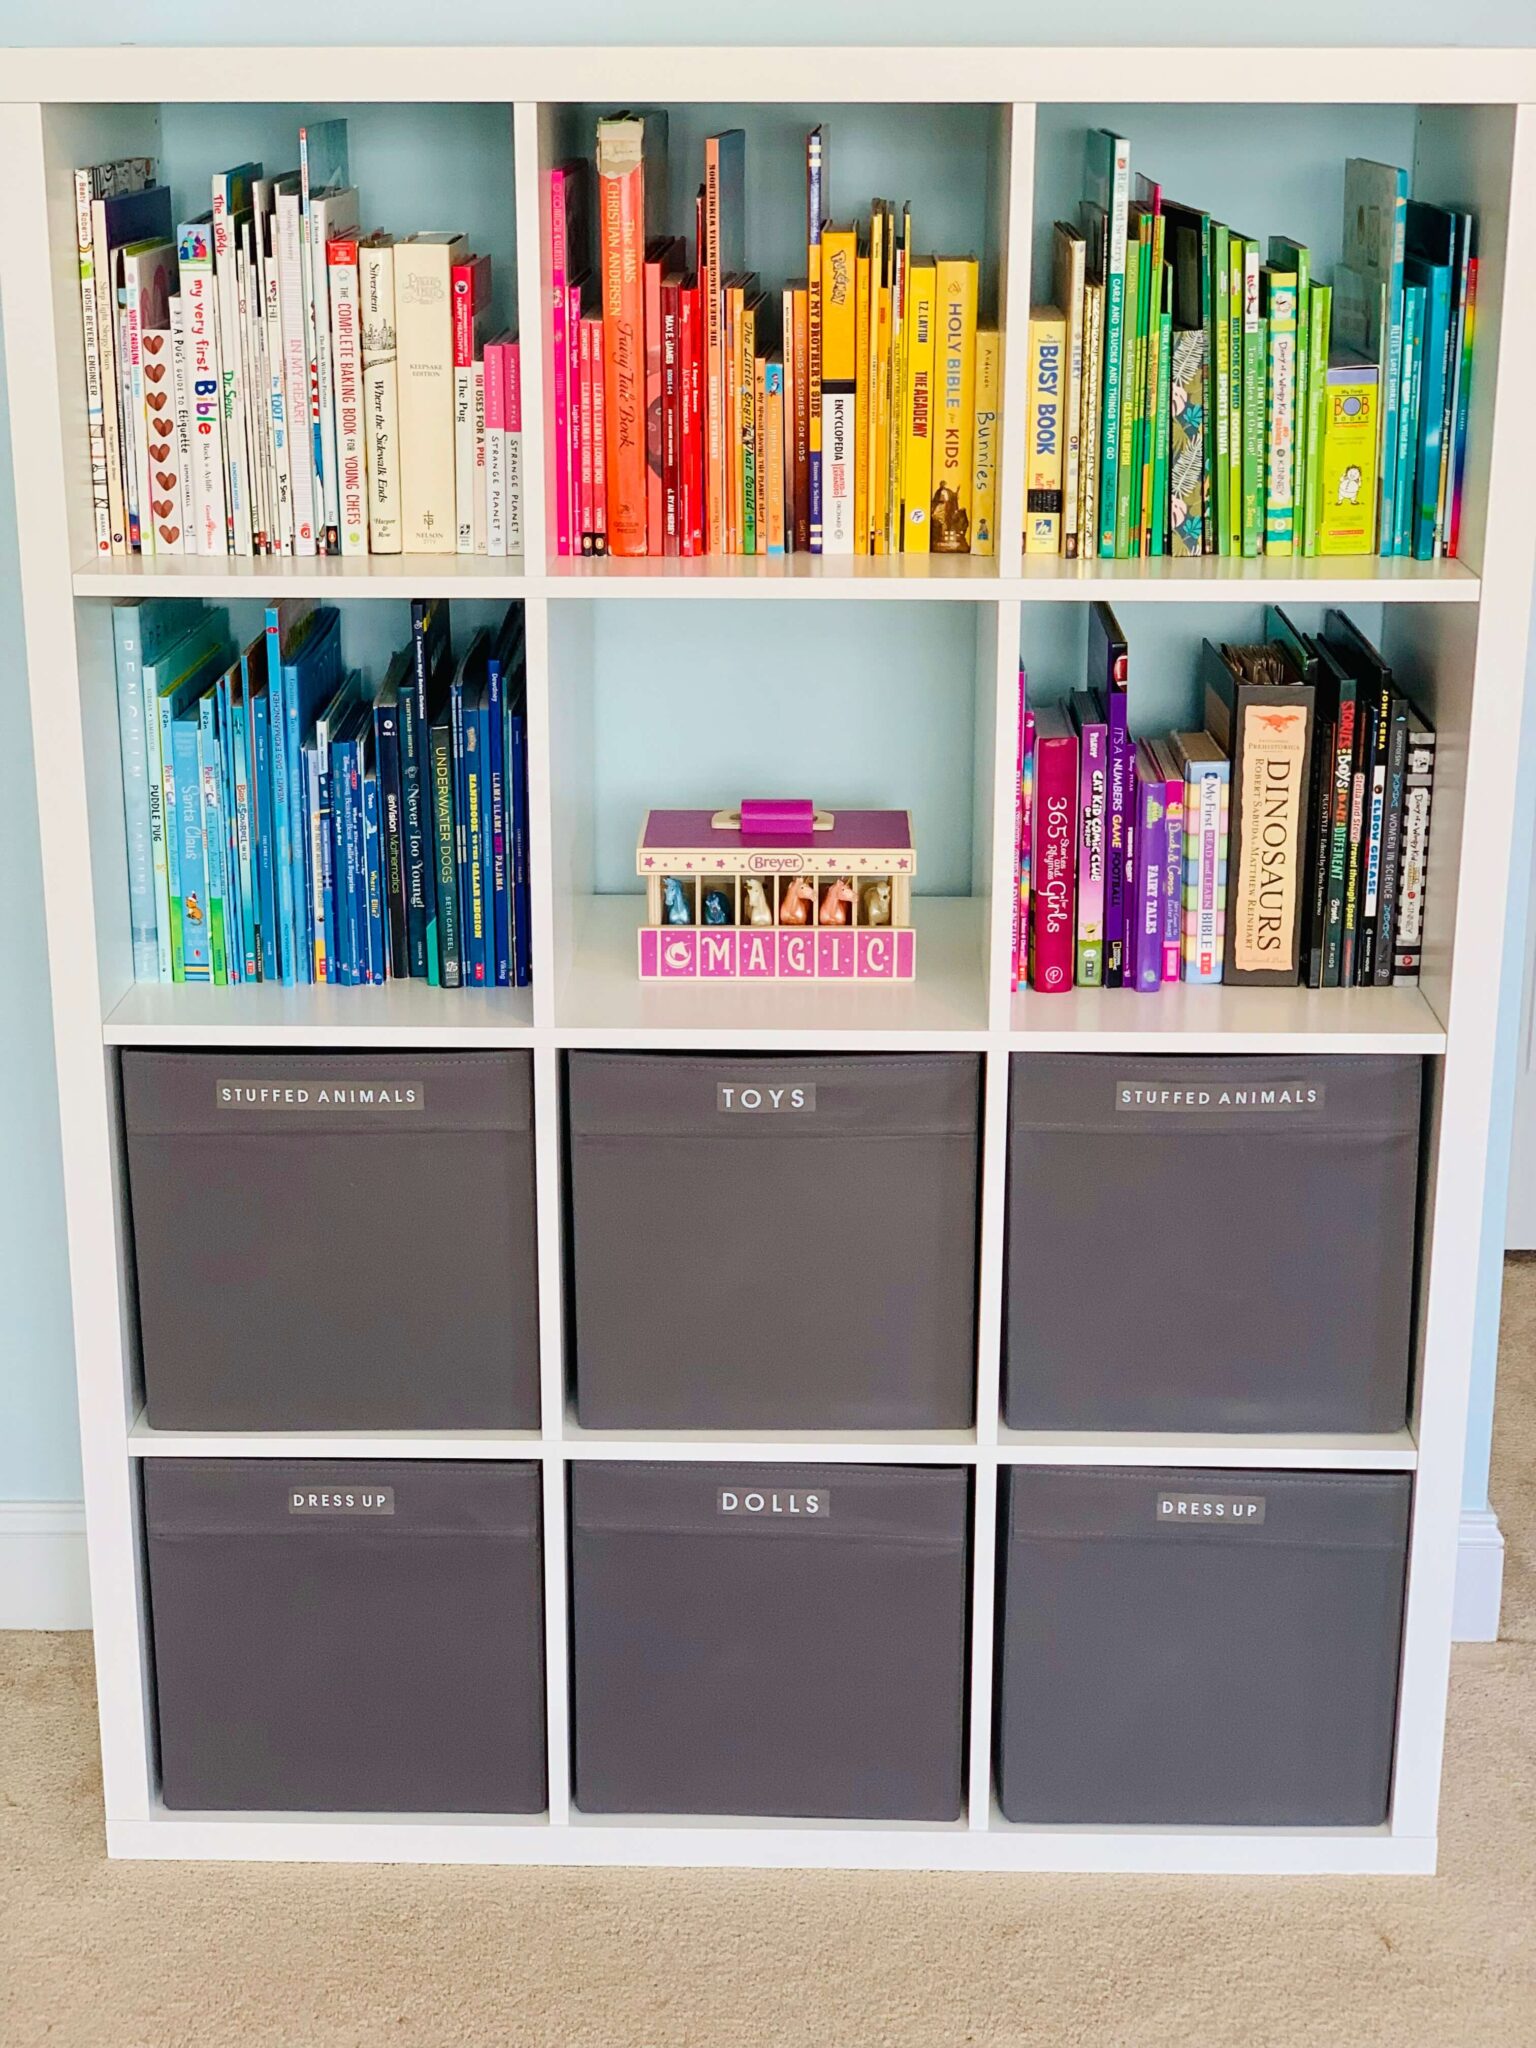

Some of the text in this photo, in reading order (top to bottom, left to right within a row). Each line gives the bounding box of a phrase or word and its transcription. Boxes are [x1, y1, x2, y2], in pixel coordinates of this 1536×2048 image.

[213, 194, 225, 214] The
[606, 181, 622, 317] CHRISTIAN ANDERSEN
[622, 219, 637, 284] The HANS
[708, 163, 718, 347] THE GREAT BAGGERMANIA WIMMELBOOK
[368, 261, 380, 313] Silverstein
[84, 288, 98, 396] ROSIE ENGINEER
[128, 309, 140, 365] NORTH CAROLINA
[189, 280, 218, 435] my very first Bible
[665, 315, 674, 331] MAX
[810, 281, 821, 418] BY MY BROTHER'S SIDE
[1232, 336, 1241, 367] BOOK
[1279, 341, 1288, 364] Diary
[409, 363, 443, 371] KEEPSAKE
[458, 376, 468, 423] The Pug
[612, 320, 636, 453] Fairy Tale Book
[945, 303, 962, 469] HOLY BIBLE KIDS
[1037, 345, 1059, 396] BUSY
[1106, 278, 1121, 460] CARS AND TRUCKS AND THINGS THAT GO
[177, 409, 190, 454] Etiquette
[293, 382, 306, 426] HEART
[338, 287, 361, 526] THE COMPLETE BAKING BOOK FOR YOUNG CHEFS
[475, 373, 485, 467] 101 USES FOR A PUG
[744, 321, 755, 510] The Little Could
[833, 399, 844, 461] ENCYCLOPEDIA
[912, 371, 928, 438] THE ACADEMY
[1036, 403, 1057, 455] BOOK
[1122, 401, 1133, 426] CLASS
[1218, 371, 1229, 455] SPORTS TRIVIA
[1333, 396, 1370, 417] BOB
[374, 380, 388, 504] Where the Sidewalk Ends
[798, 441, 806, 462] KIDS
[976, 411, 996, 491] Bunnies
[491, 436, 501, 530] STRANGE PLANET
[510, 439, 520, 534] STRANGE PLANET
[491, 673, 499, 702] Dewdney
[1378, 688, 1389, 750] JOHN CENA
[1339, 700, 1356, 749] STORIES
[150, 784, 162, 842] PUDDLE PUG
[181, 785, 201, 860] Santa Claus
[435, 746, 451, 842] UNDERWATER
[1090, 770, 1104, 882] CAT CLUB
[1110, 726, 1124, 907] IT'S A NUMBERS GAME FOOTBALL
[1251, 757, 1265, 839] ROBERT SABUDA
[1410, 794, 1424, 862] Diary Wimpy Kid
[387, 794, 400, 894] enVision Mathematics
[407, 783, 425, 908] Never Too Young!
[440, 845, 453, 884] DOGS
[468, 773, 482, 939] HANDBOOK GALAR REGION
[492, 772, 503, 892] LLAMA LLAMA PAJAMA
[753, 856, 800, 872] Breyer
[1037, 795, 1070, 933] 365 Stories and Rhymes Girls
[1166, 822, 1181, 897] Duck Goose
[1200, 782, 1217, 949] My First READ and LEARN BIBLE
[1256, 758, 1292, 952] DINOSAURS
[1345, 774, 1364, 930] Stella and Steve travel through Space!
[1367, 798, 1382, 896] ELBOW GREASE
[1383, 812, 1399, 900] WOMEN IN SCIENCE
[1146, 864, 1159, 935] FAIRY TALES
[1245, 847, 1260, 950] MATTHEW REINHART
[1405, 901, 1415, 934] KINNEY
[446, 917, 454, 951] CASTEEL
[701, 936, 885, 973] MAGIC
[222, 1088, 416, 1103] STUFFED ANIMALS
[722, 1088, 805, 1109] TOYS
[1121, 1089, 1317, 1105] STUFFED ANIMALS
[293, 1494, 387, 1508] DRESS UP
[722, 1492, 820, 1514] DOLLS
[1162, 1501, 1258, 1518] DRESS UP
